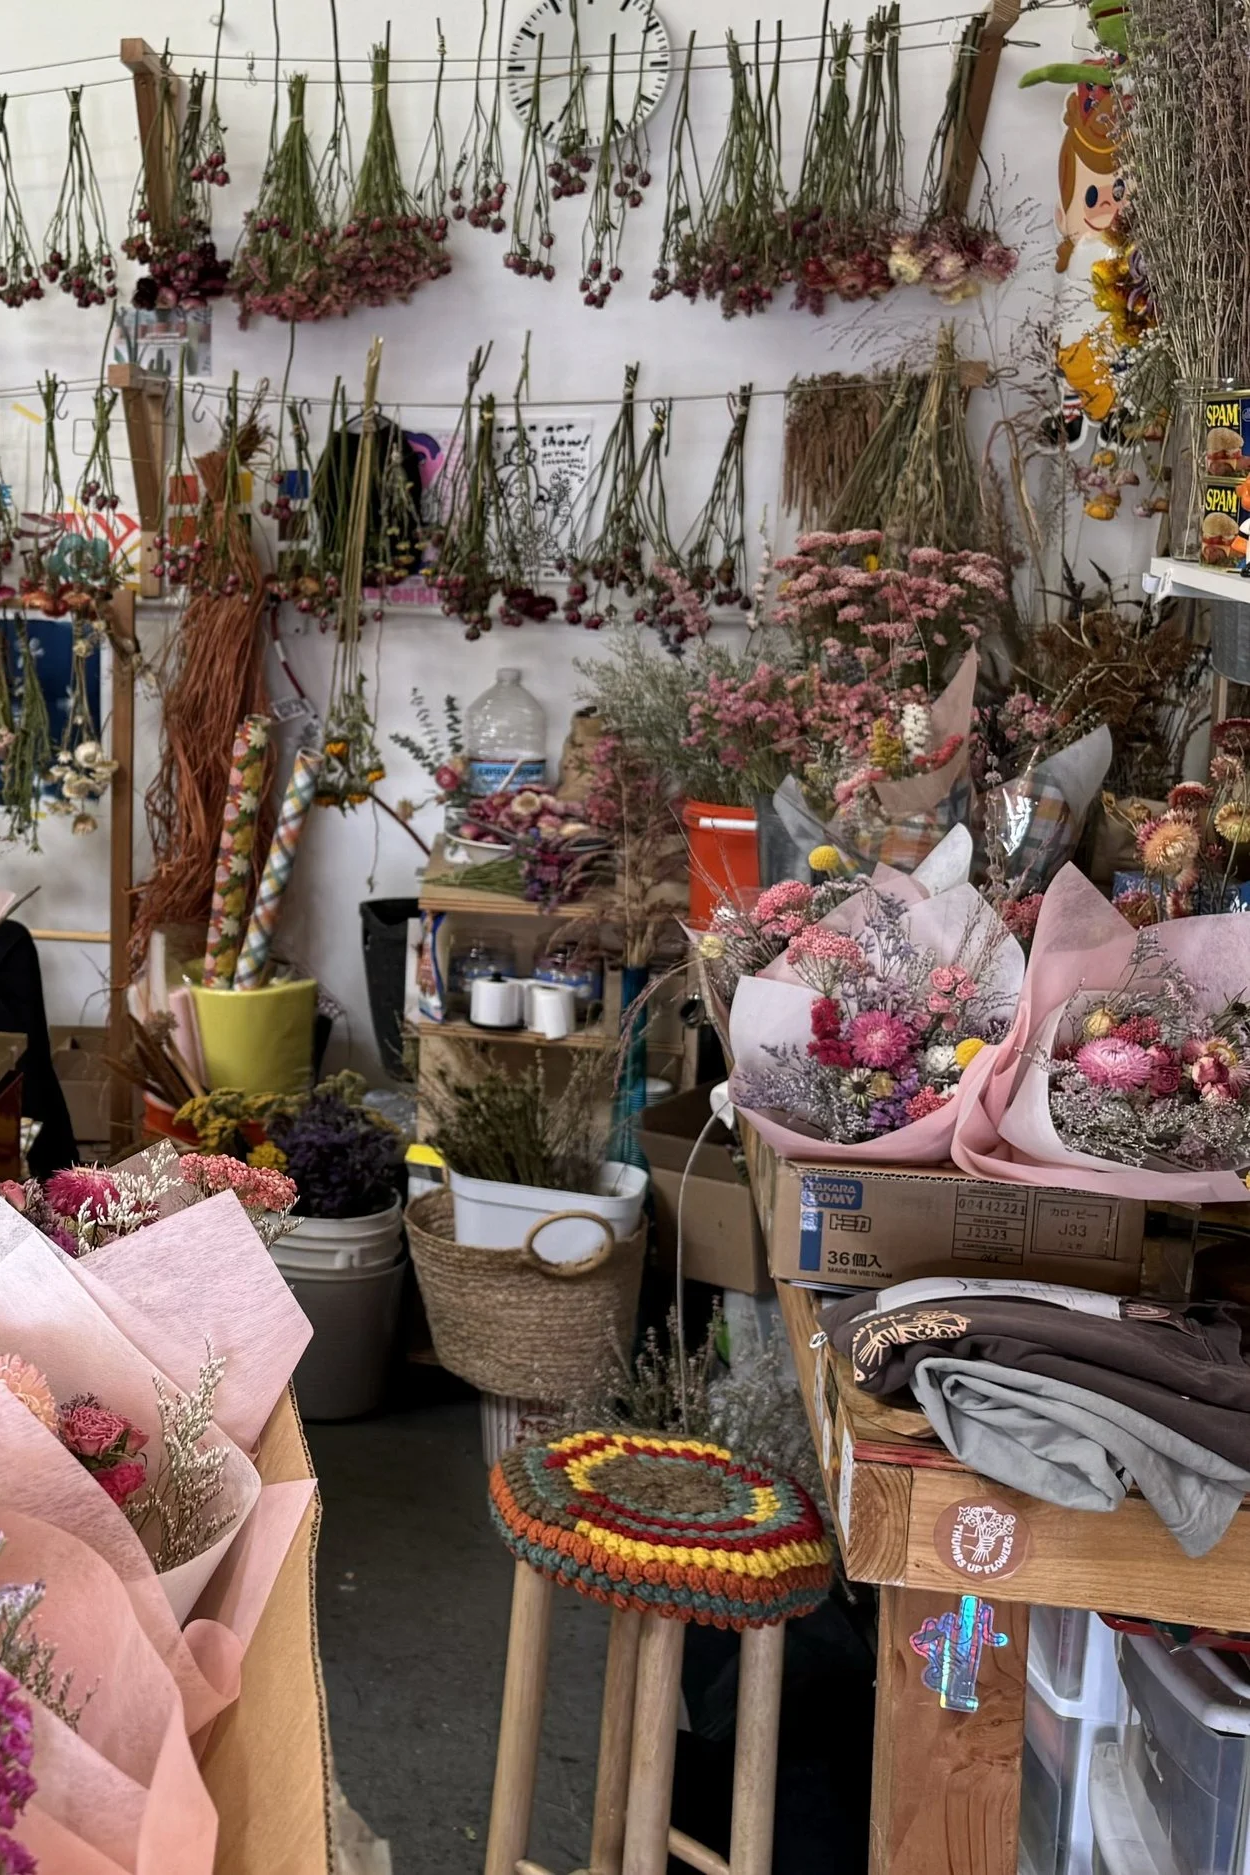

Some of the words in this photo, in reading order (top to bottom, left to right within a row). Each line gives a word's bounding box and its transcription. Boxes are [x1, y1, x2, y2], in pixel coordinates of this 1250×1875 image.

[1206, 403, 1239, 427] SPAM
[1205, 488, 1237, 513] SPAM
[809, 1182, 856, 1194] TAKARA
[813, 1192, 855, 1205] OMY
[830, 1213, 872, 1233] トミカ
[1058, 1224, 1087, 1238] J33
[827, 1250, 882, 1269] 36個入
[827, 1267, 848, 1275] MADE
[858, 1270, 893, 1279] VIETNAM
[951, 1524, 967, 1567] THUMBS
[967, 1563, 982, 1573] UP
[984, 1536, 1014, 1574] FLOWERS
